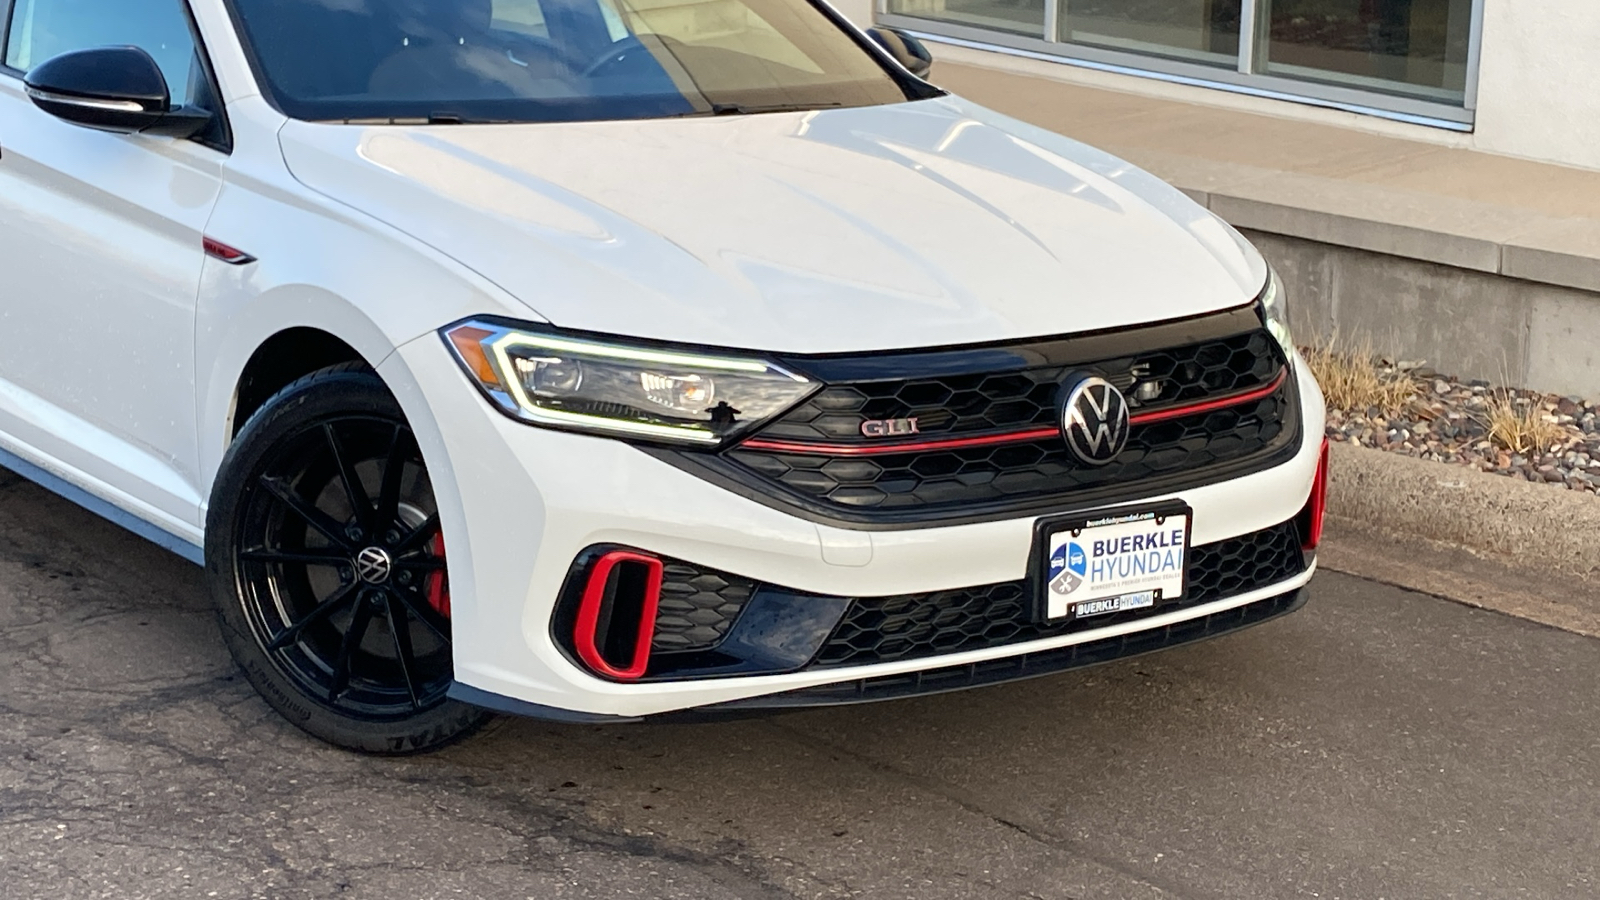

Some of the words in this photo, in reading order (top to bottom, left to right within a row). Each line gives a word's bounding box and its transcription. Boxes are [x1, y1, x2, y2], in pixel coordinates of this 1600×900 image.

[862, 417, 920, 437] GLI
[1086, 512, 1155, 527] buerklehyundai.com
[1093, 529, 1183, 557] BUERKLE
[1091, 549, 1182, 583] HYUNDAI
[1077, 597, 1120, 616] BUERKLE
[1120, 593, 1152, 608] HYUNDAI
